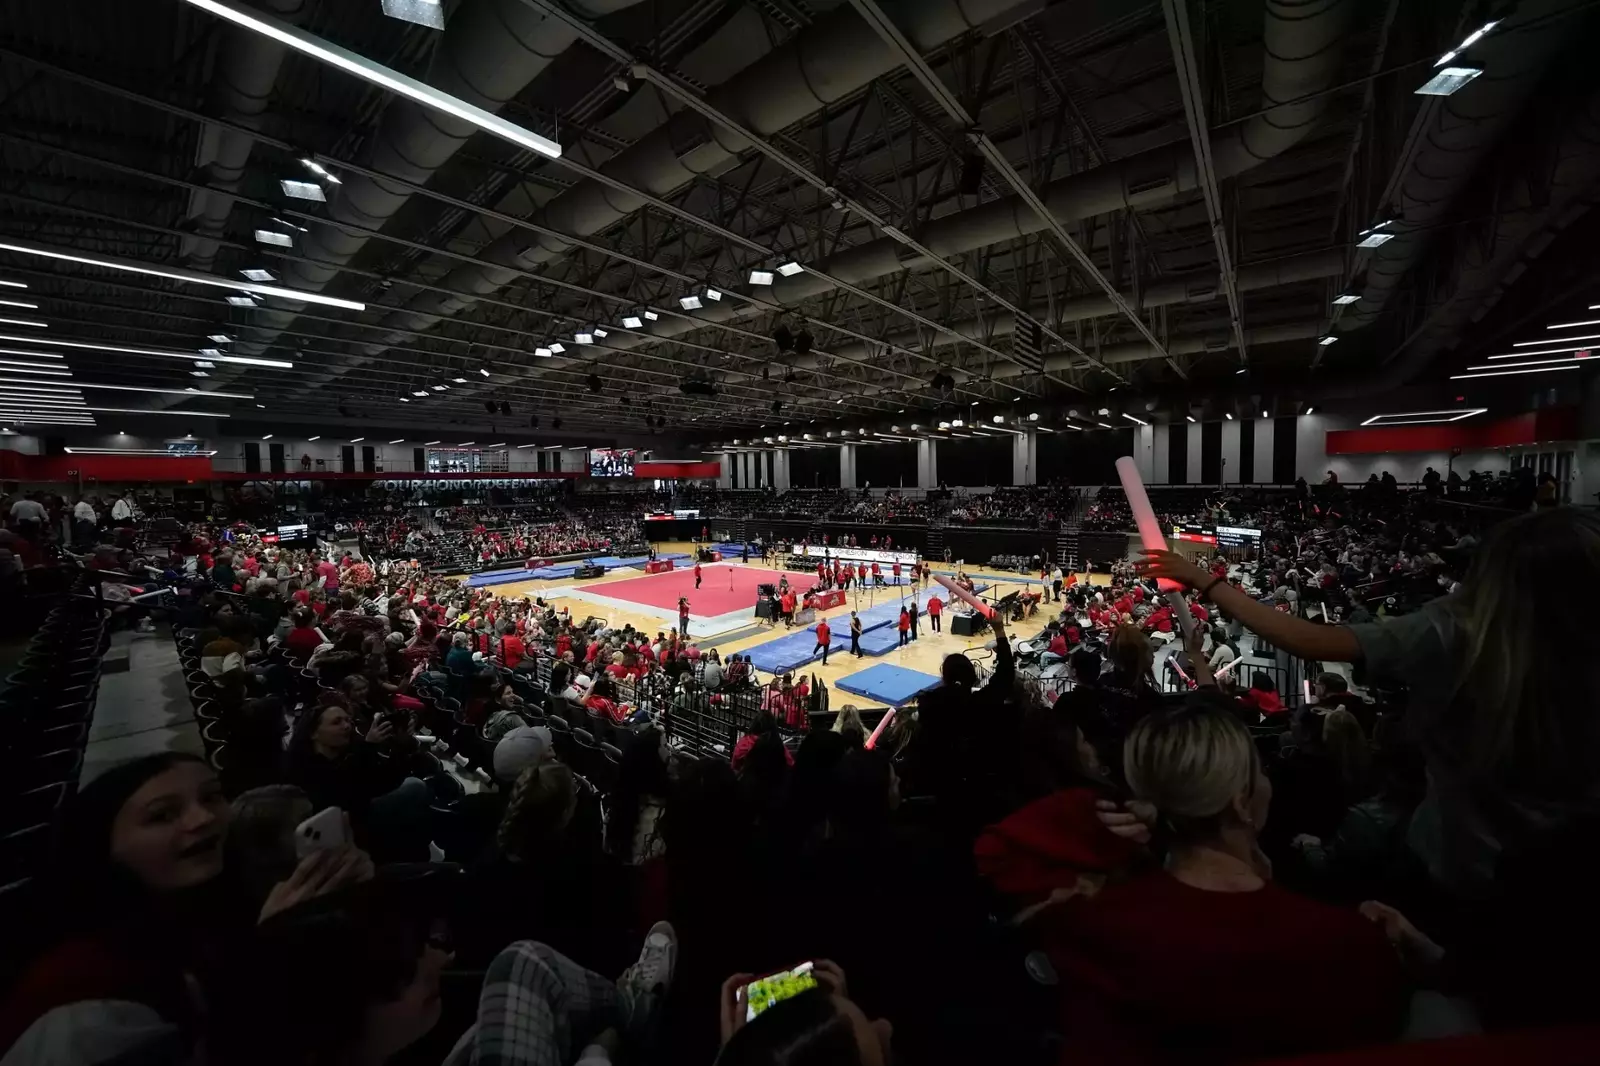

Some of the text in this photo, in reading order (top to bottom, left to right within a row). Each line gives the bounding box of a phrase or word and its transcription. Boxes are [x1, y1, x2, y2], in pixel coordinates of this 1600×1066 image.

[383, 478, 537, 492] OUR HONOR DEFEND
[834, 548, 868, 557] COHESION
[879, 550, 916, 561] COHESION
